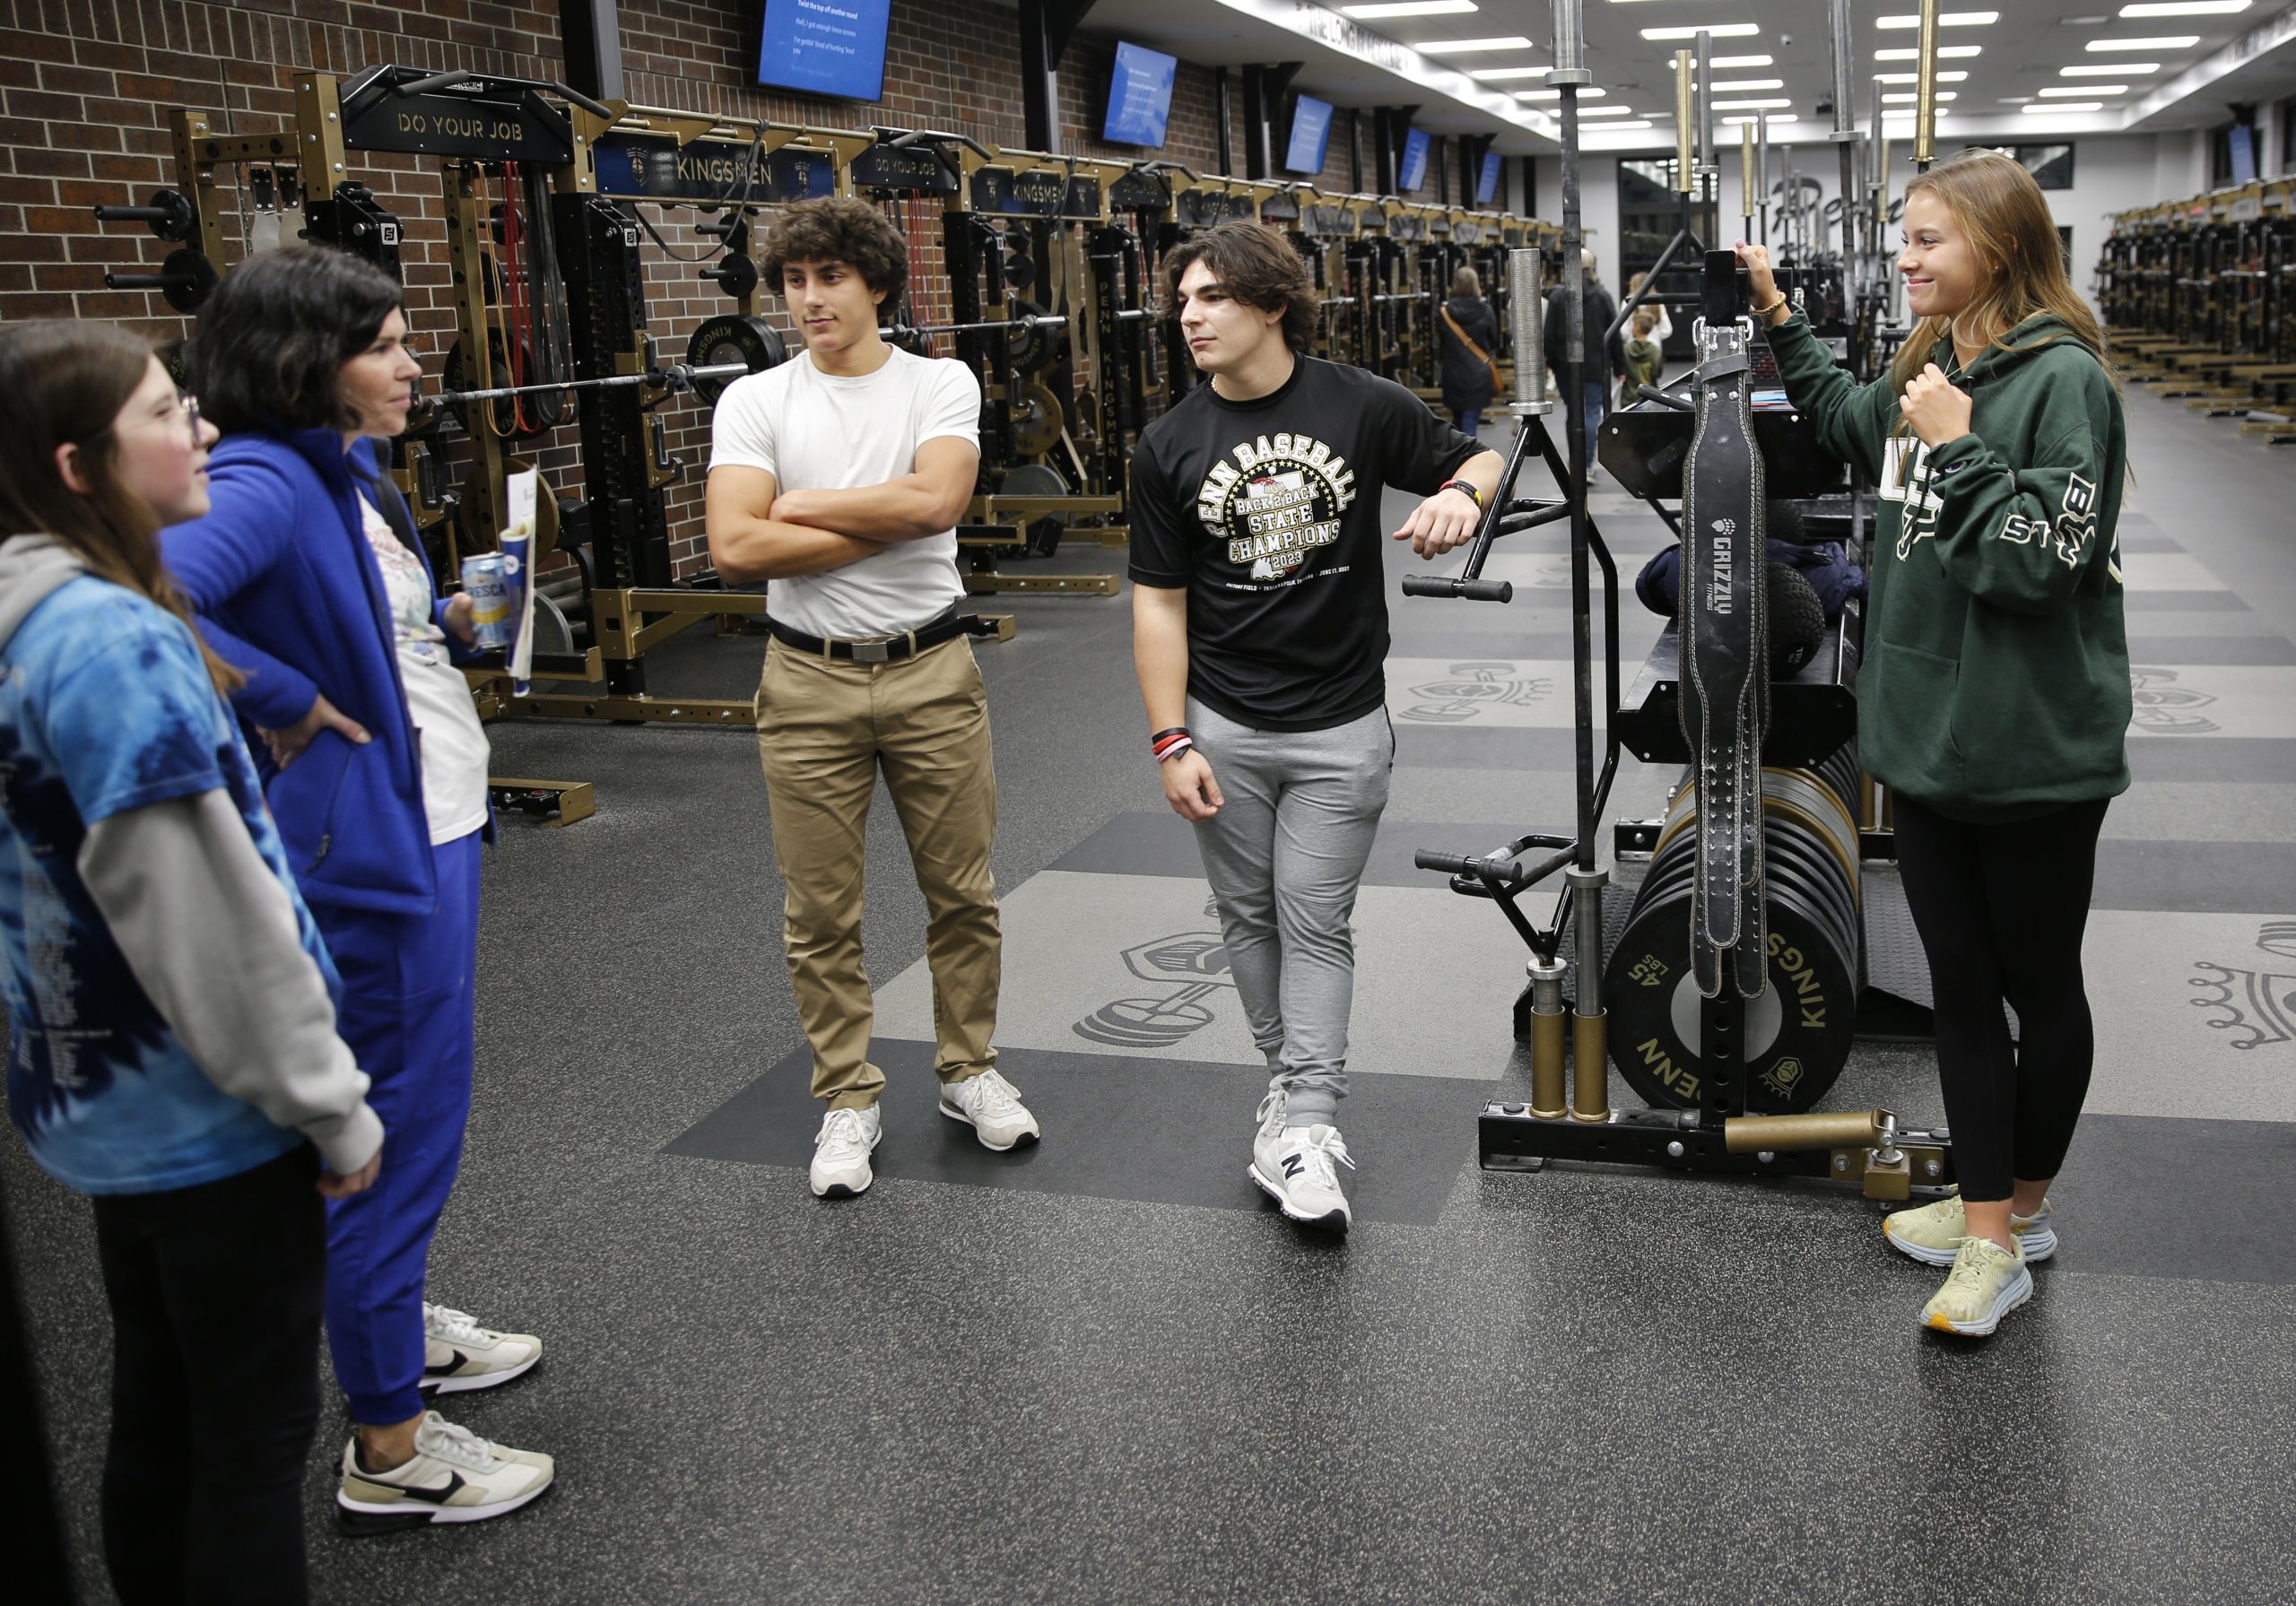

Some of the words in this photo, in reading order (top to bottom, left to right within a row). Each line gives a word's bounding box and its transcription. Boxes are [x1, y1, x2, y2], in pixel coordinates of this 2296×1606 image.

[809, 2, 817, 10] the
[831, 7, 846, 17] another
[846, 12, 858, 20] round
[398, 112, 426, 134] DO
[432, 116, 483, 138] YOUR
[490, 121, 523, 141] JOB
[677, 157, 772, 186] KINGSMEN
[875, 158, 889, 172] DO
[892, 160, 917, 175] YOUR
[919, 162, 935, 176] JOB
[1100, 282, 1111, 334] PENN
[1103, 352, 1118, 457] KINGSMEN
[1198, 459, 1241, 538] PENN
[1232, 432, 1357, 512] BASEBALL
[1234, 495, 1270, 516] BACK
[1272, 495, 1283, 508] 2
[1284, 482, 1319, 504] BACK
[1248, 502, 1314, 534] STATE
[1228, 518, 1342, 564] CHAMPIONS
[1271, 550, 1303, 570] 2023
[1713, 536, 1732, 614] GRIZZLY
[1628, 963, 1661, 986] 45
[1642, 953, 1669, 976] LBS
[1637, 1038, 1701, 1102] ENN
[1281, 1153, 1306, 1180] N
